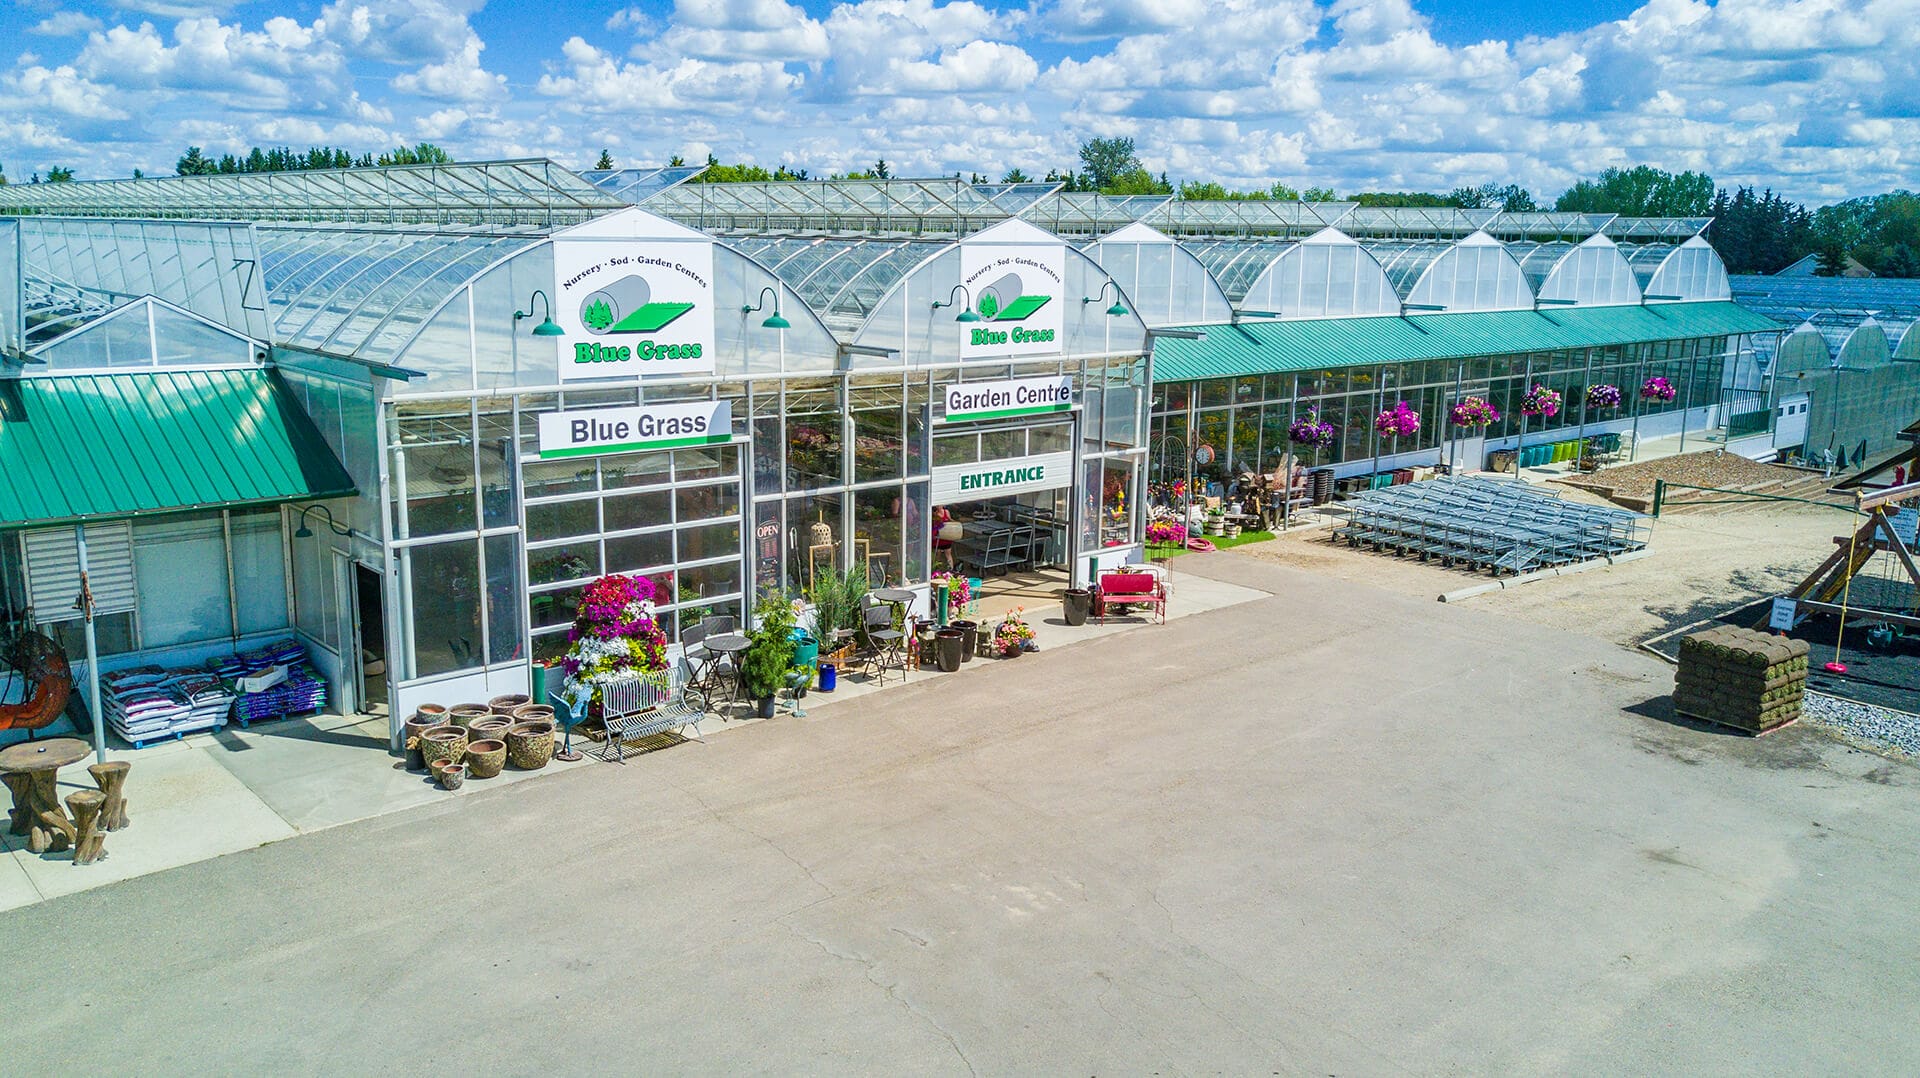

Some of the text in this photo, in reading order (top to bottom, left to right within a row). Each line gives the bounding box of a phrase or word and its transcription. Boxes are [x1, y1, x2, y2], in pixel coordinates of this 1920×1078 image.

[563, 255, 707, 290] Nursery Sod Garden Centres
[965, 257, 1061, 286] Nursery Sod Garden Centres
[970, 326, 1055, 346] Blue Grass
[574, 340, 703, 363] Blue Grass
[949, 384, 1070, 410] Garden Centre
[571, 414, 707, 443] Blue Grass
[960, 466, 1044, 490] ENTRANCE
[757, 525, 778, 538] OPEN
